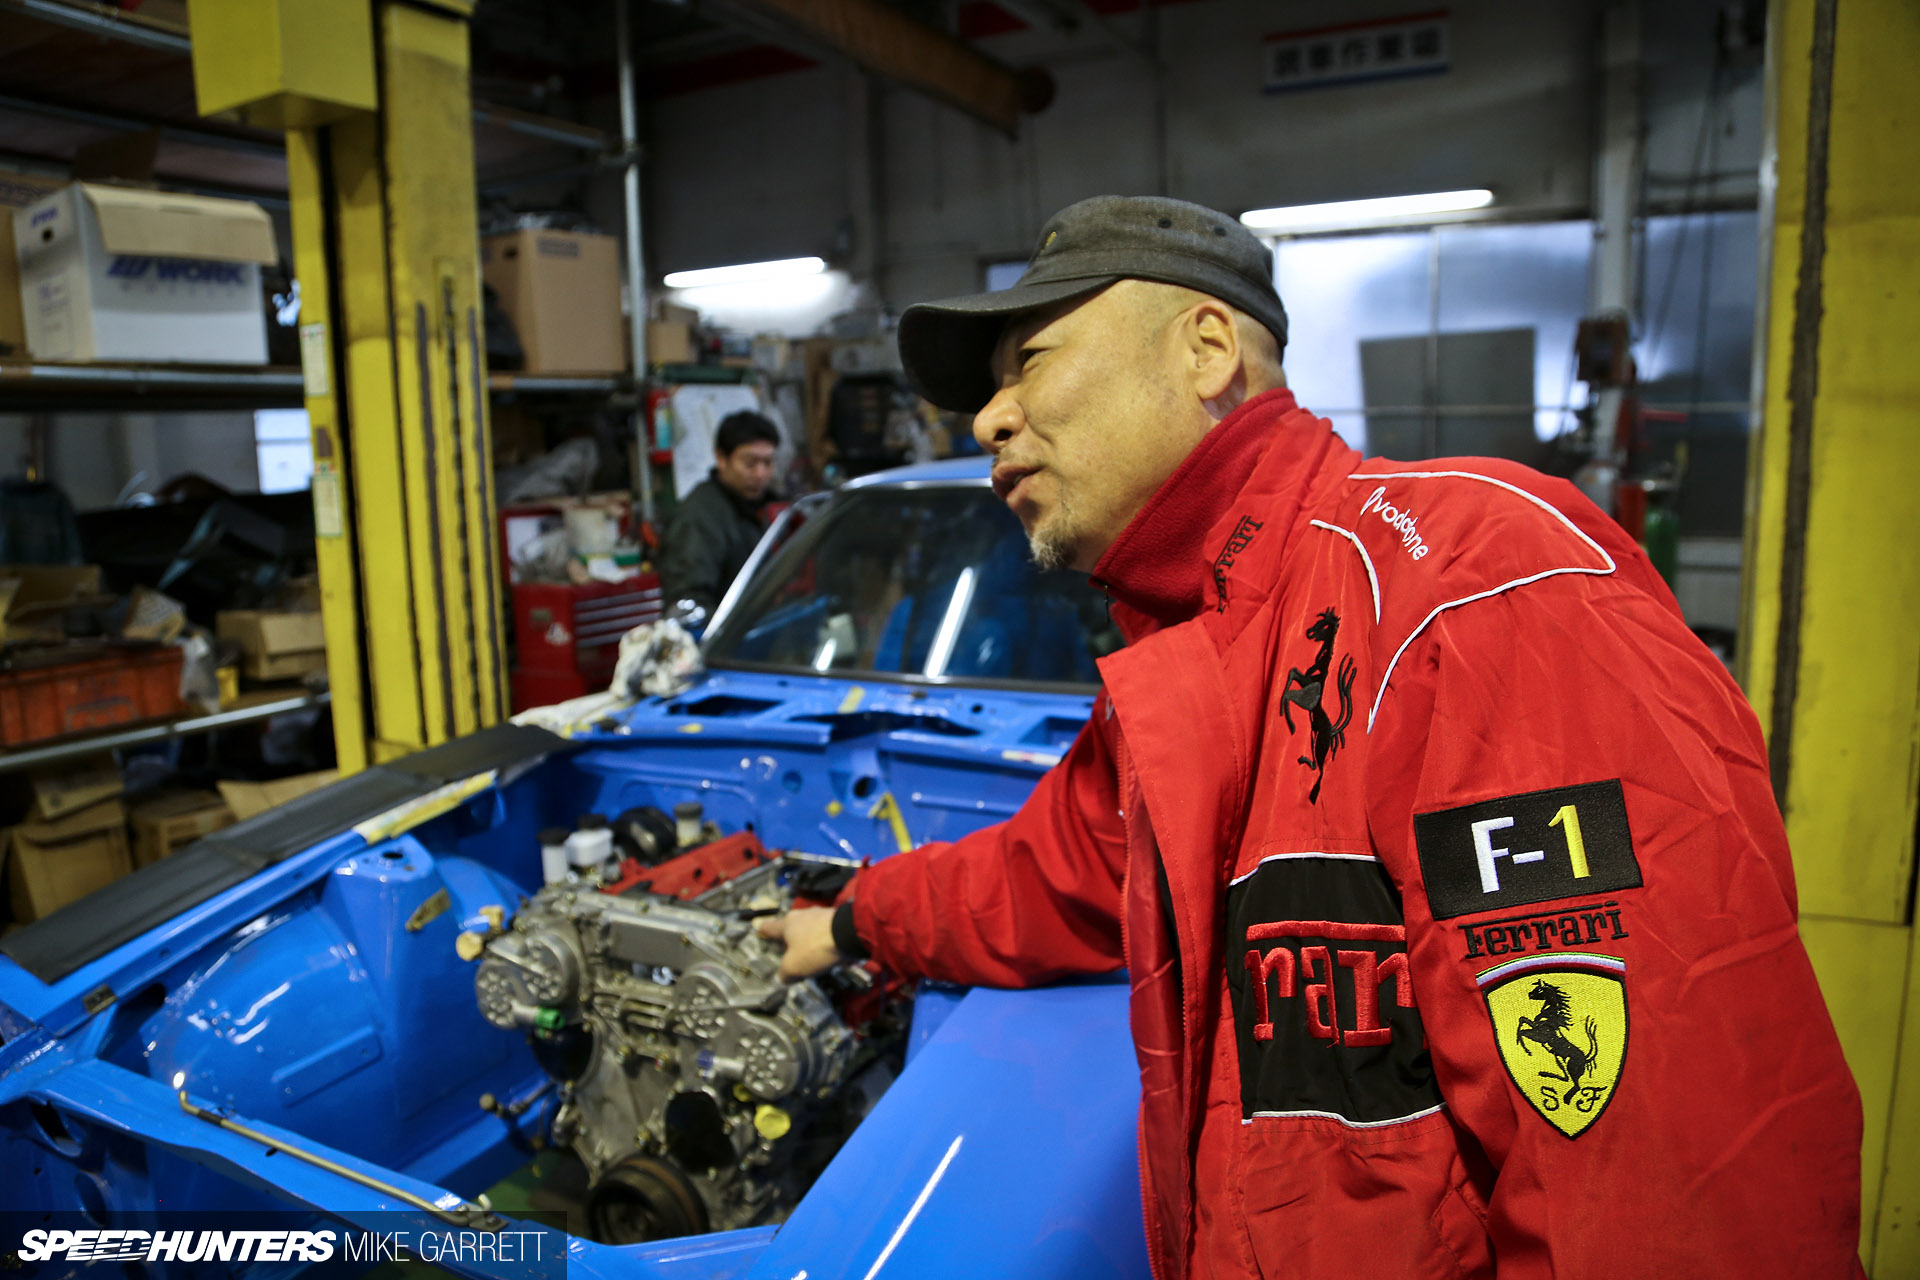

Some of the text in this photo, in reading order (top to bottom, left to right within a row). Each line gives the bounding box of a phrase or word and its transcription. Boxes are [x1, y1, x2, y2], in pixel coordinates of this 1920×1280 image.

[1471, 804, 1592, 894] F-1
[1457, 900, 1629, 959] Ferrari
[1244, 919, 1428, 1050] rar
